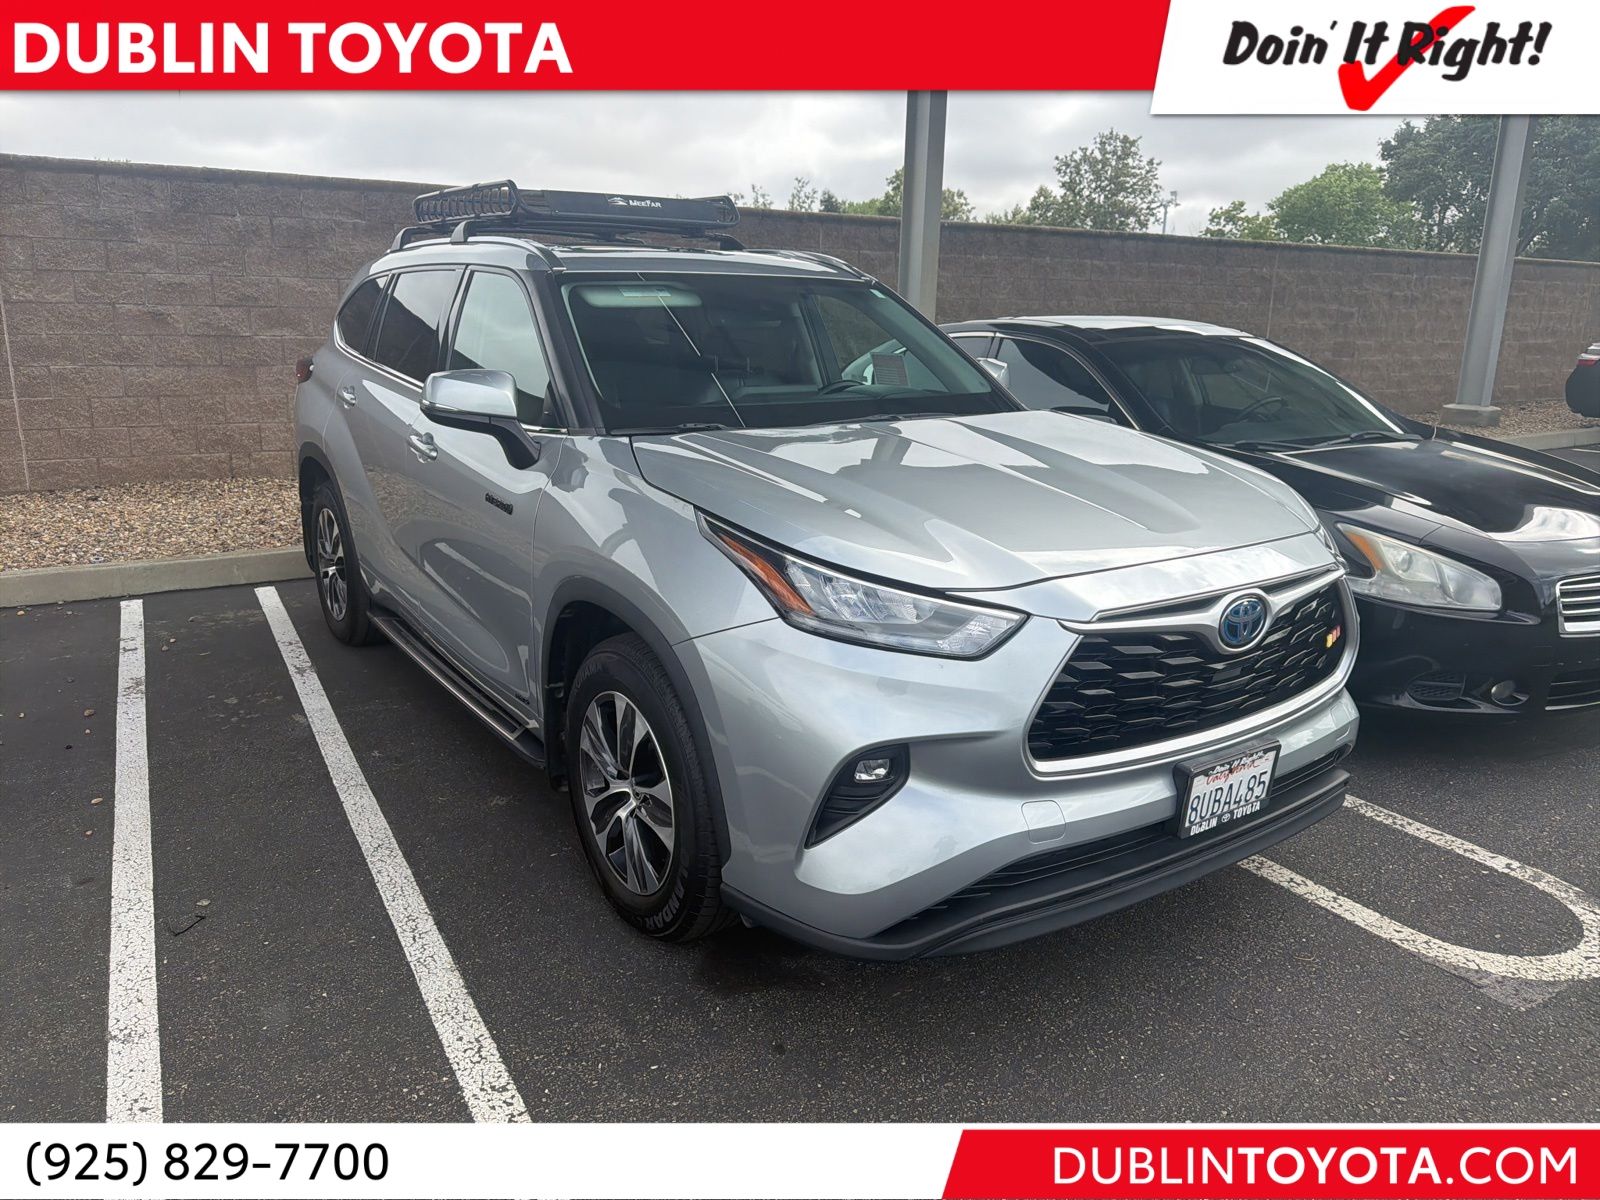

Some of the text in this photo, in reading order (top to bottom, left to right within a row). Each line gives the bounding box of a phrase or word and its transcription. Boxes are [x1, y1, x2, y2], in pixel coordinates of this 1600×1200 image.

[1188, 770, 1268, 825] 8UBA485
[1190, 800, 1260, 836] DUBLIN TOYOTA
